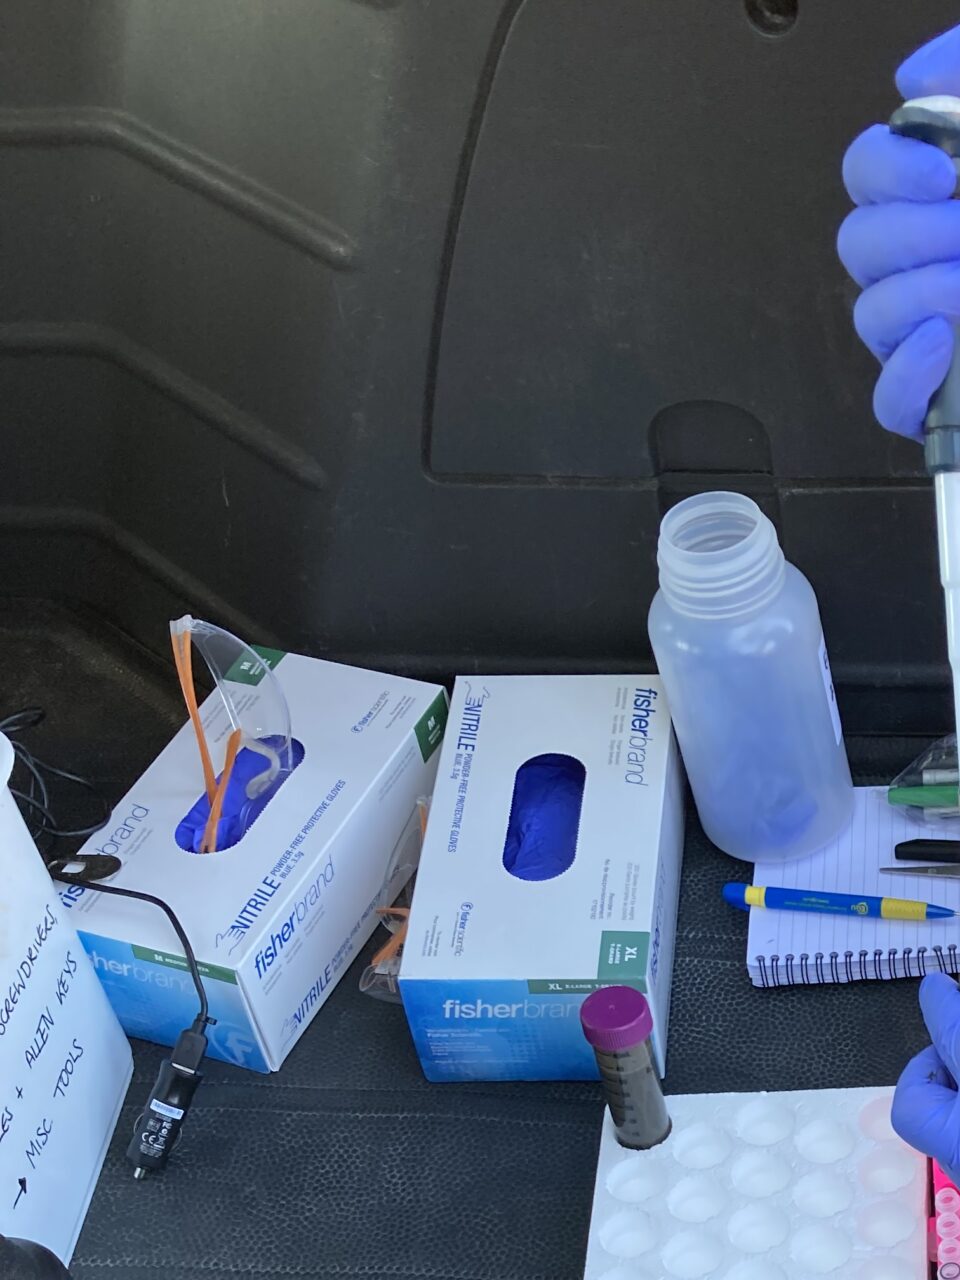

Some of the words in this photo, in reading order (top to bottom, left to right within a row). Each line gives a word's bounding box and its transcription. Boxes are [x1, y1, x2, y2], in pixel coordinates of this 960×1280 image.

[457, 703, 482, 752] NITRILE
[625, 688, 658, 787] fisherbrand
[458, 753, 473, 795] POWDER-FREE
[270, 834, 305, 877] POWDER-FREE
[301, 800, 331, 835] PROTECTIVE
[325, 779, 346, 802] GLOVES
[451, 795, 467, 828] PROTECTIVE
[448, 829, 460, 853] GLOVES
[231, 876, 282, 930] NITRILE
[254, 854, 336, 979] fisherbrand
[624, 946, 637, 961] XL
[25, 1006, 54, 1069] ALLEN
[55, 950, 77, 1006] KEYS
[293, 965, 332, 1025] NITRILE
[442, 999, 580, 1019] fisherbran
[53, 1038, 84, 1098] TOOLS
